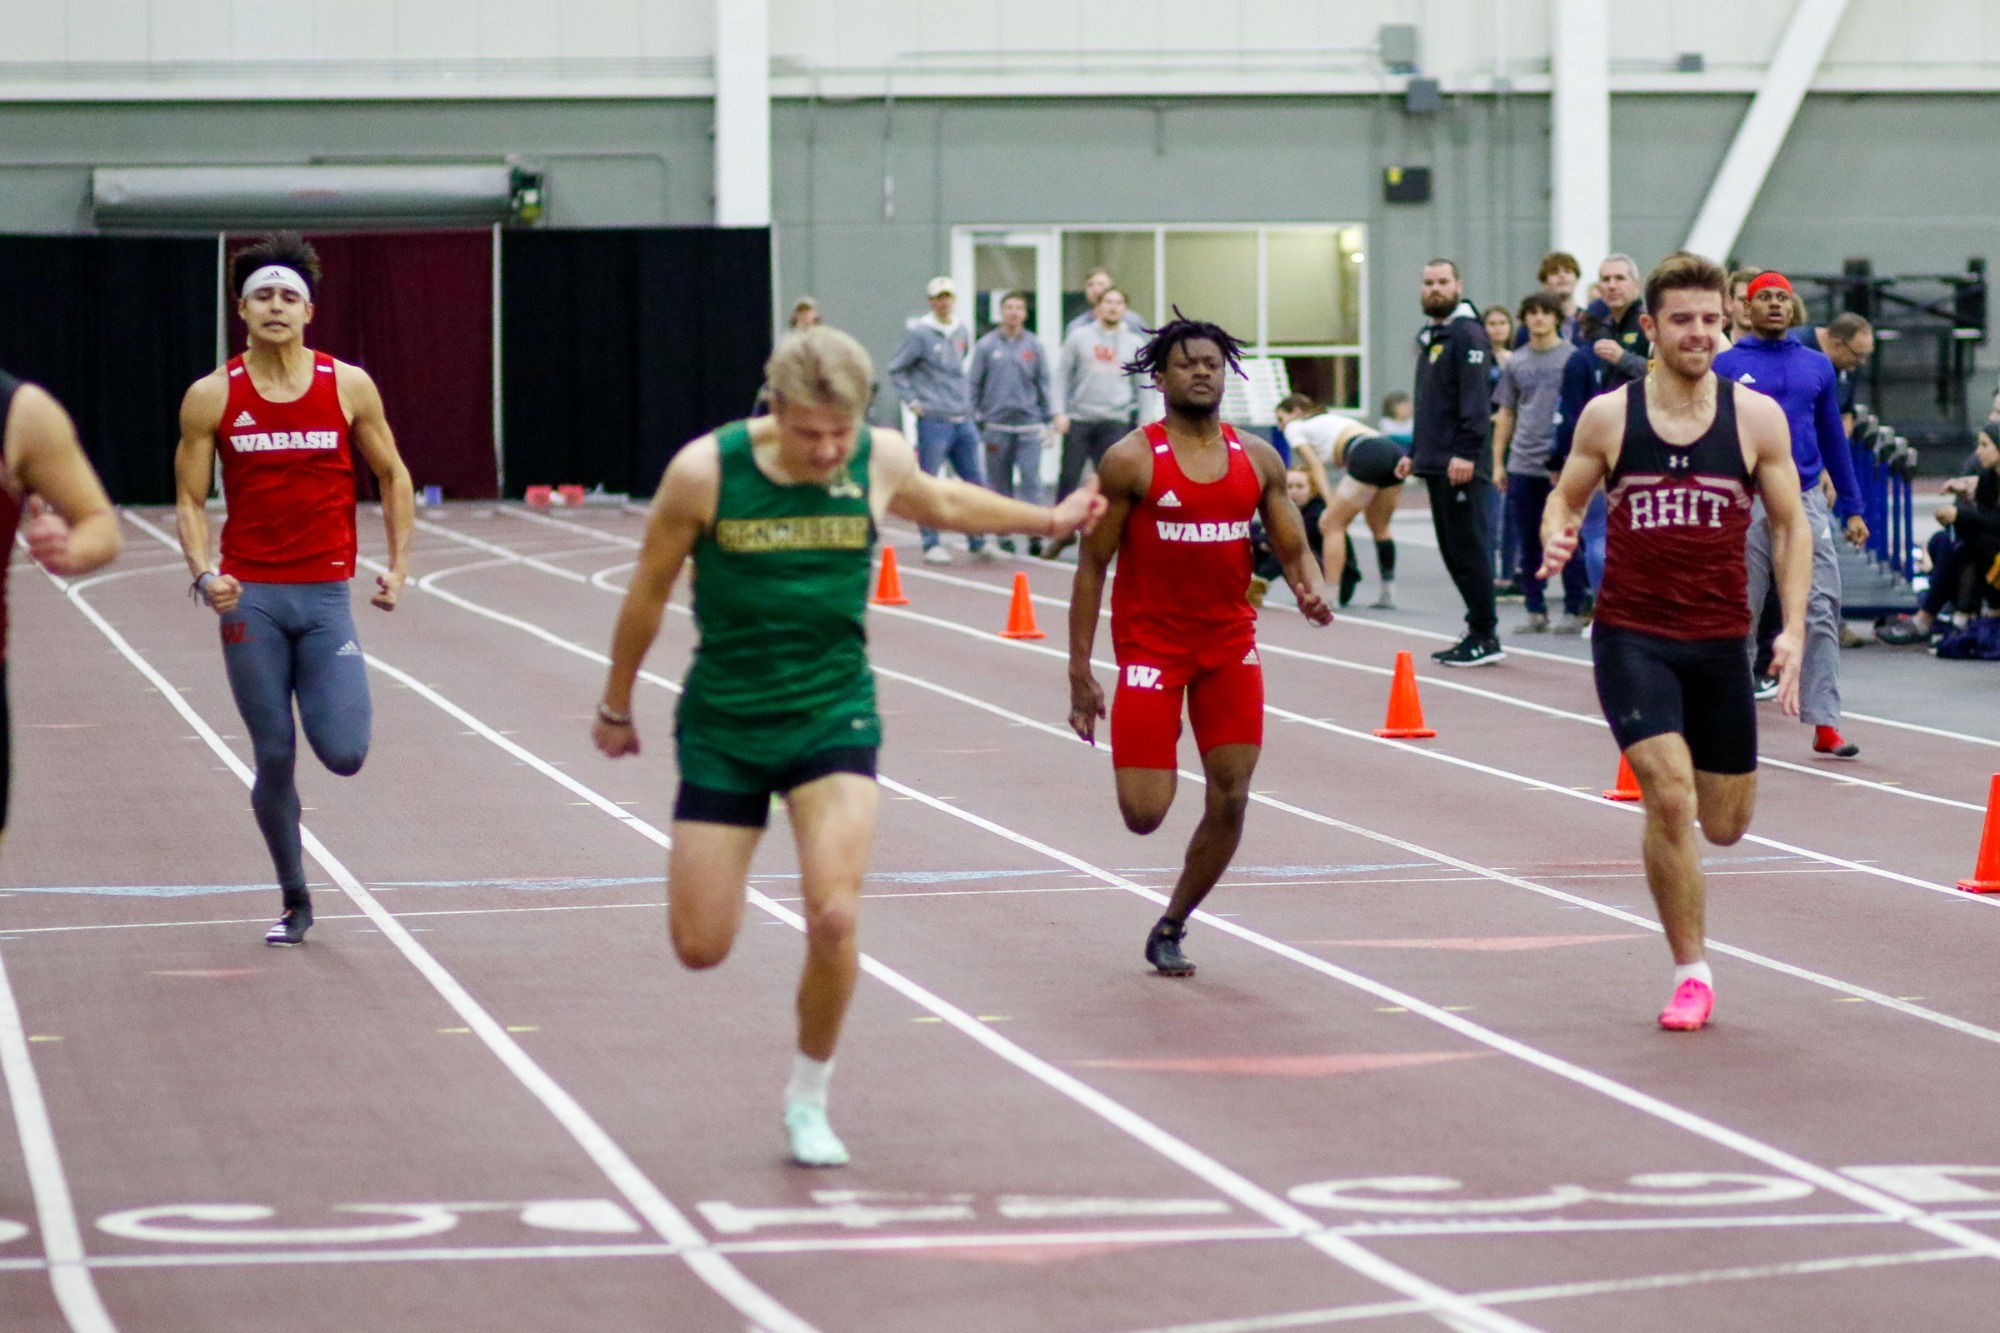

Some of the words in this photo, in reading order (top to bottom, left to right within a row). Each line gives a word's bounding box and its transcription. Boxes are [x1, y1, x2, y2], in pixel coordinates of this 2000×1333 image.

[229, 431, 338, 452] WABASH
[1628, 488, 1730, 530] RHIT
[1127, 664, 1163, 690] W.
